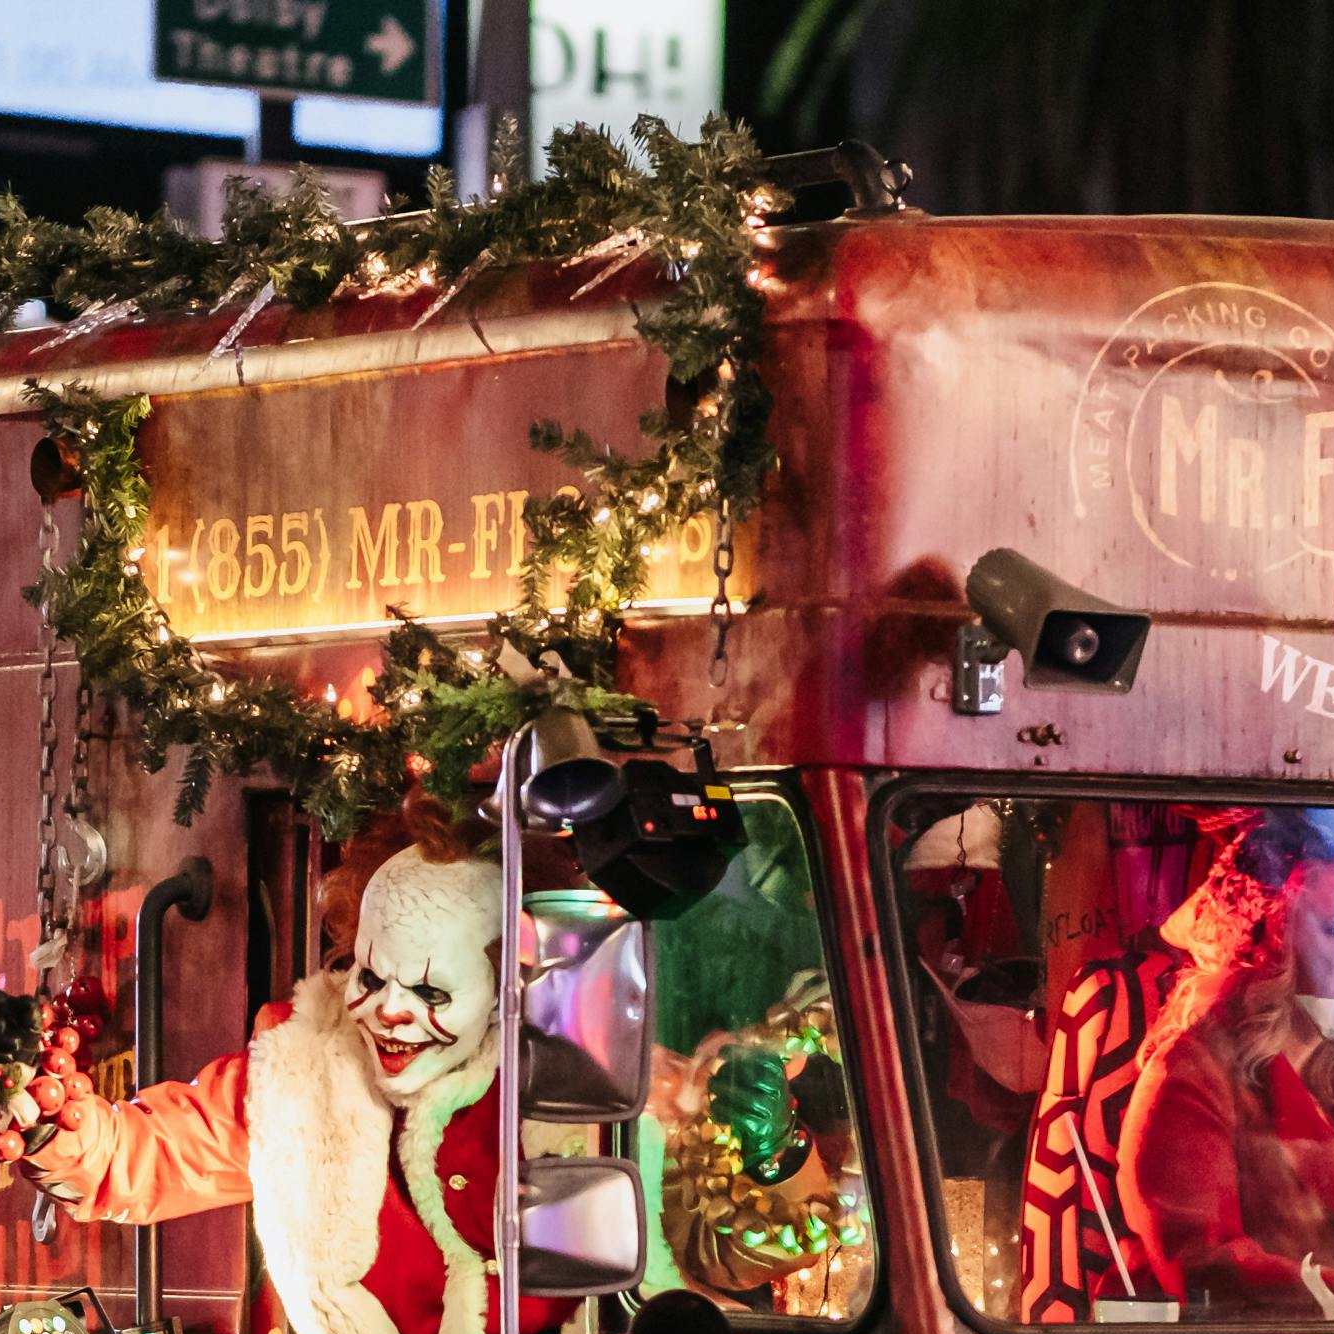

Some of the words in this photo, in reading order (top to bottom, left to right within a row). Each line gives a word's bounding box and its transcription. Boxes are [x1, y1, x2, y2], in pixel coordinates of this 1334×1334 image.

[172, 28, 354, 88] Theatre
[1160, 394, 1285, 529] MR.
[155, 523, 172, 605] 1
[187, 508, 332, 614] (855)
